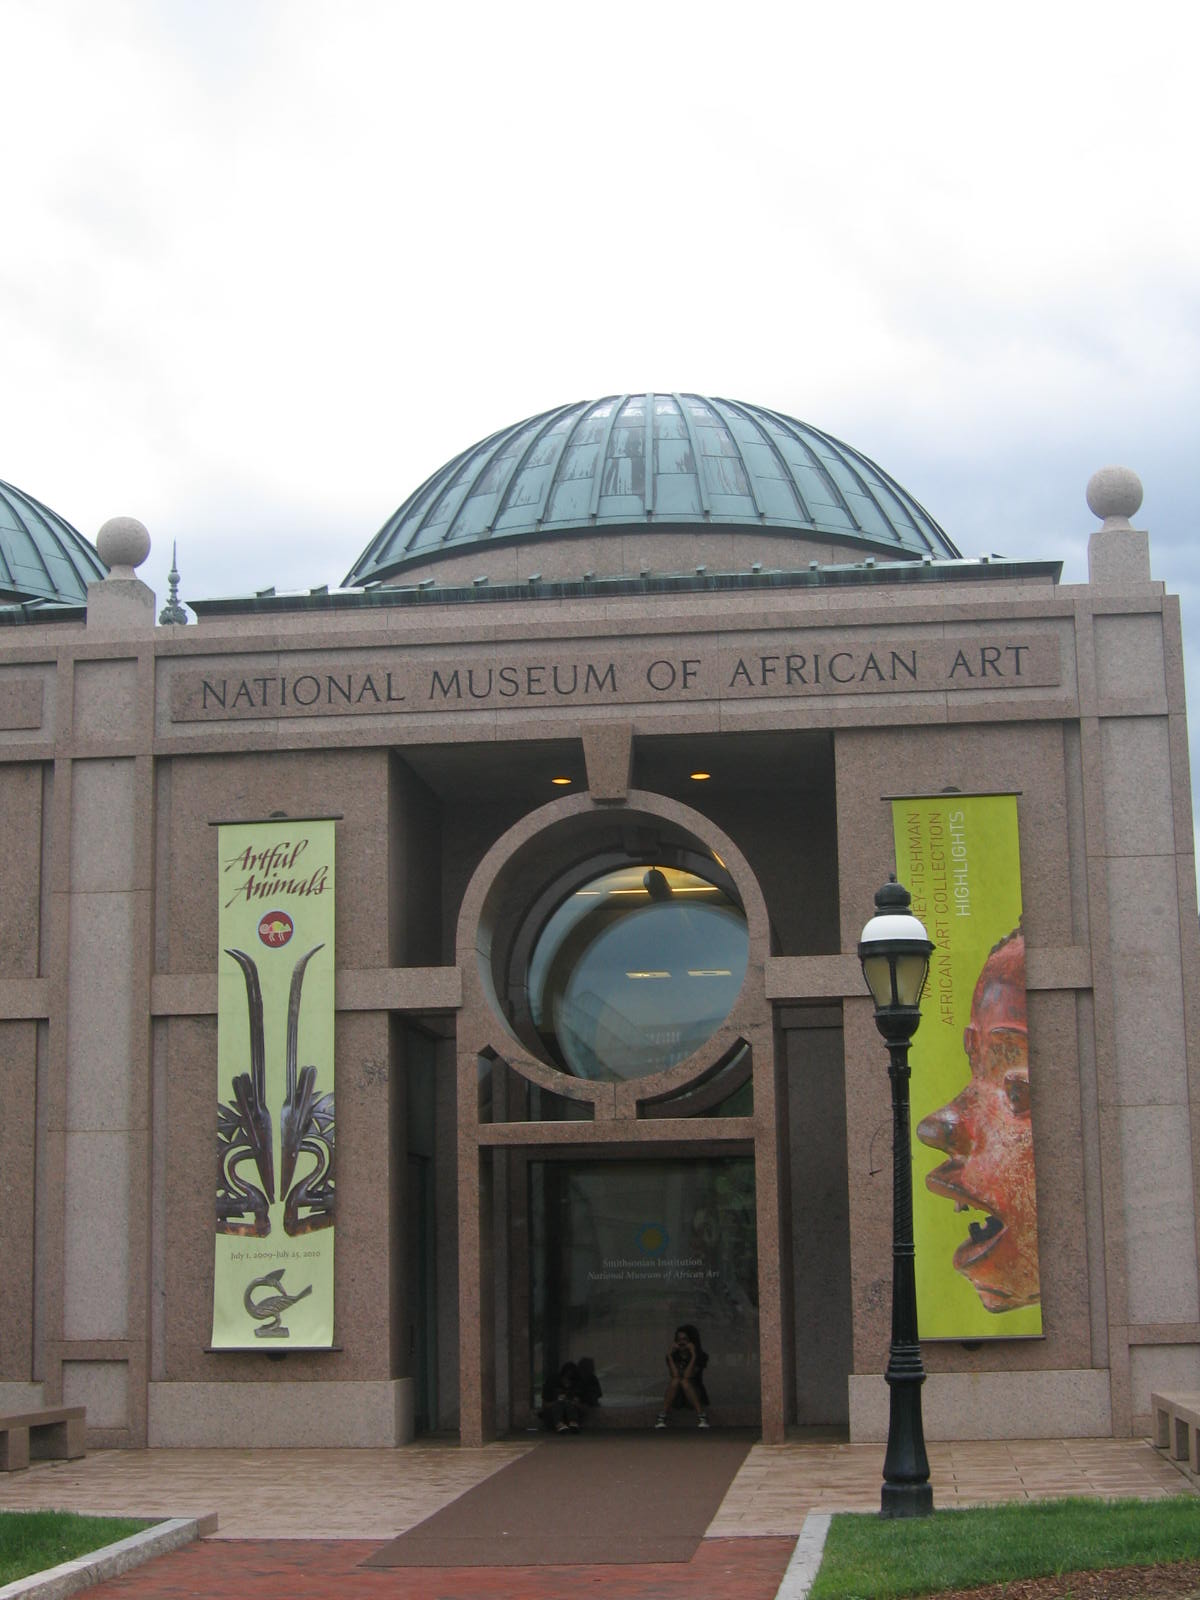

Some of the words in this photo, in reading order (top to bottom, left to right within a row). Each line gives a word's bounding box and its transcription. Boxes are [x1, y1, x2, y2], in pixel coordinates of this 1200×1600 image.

[200, 672, 406, 710] NATIONAL
[428, 663, 619, 700] MUSEUM
[646, 659, 701, 691] OF
[728, 650, 919, 688] AFRICAN
[947, 646, 1030, 679] ART
[224, 839, 309, 878] Artful
[928, 812, 949, 914] COLLECTION
[949, 810, 971, 917] HIGHLIGHTS
[225, 865, 333, 908] Animals
[936, 920, 952, 950] ART
[936, 955, 954, 1026] AFRICAN
[230, 1251, 246, 1261] July
[303, 1250, 321, 1259] 2010
[587, 1271, 624, 1281] National
[626, 1271, 662, 1280] Museum
[673, 1270, 704, 1280] African
[705, 1269, 721, 1279] Art
[602, 1257, 656, 1268] Smithsonian
[657, 1256, 703, 1268] Institution
